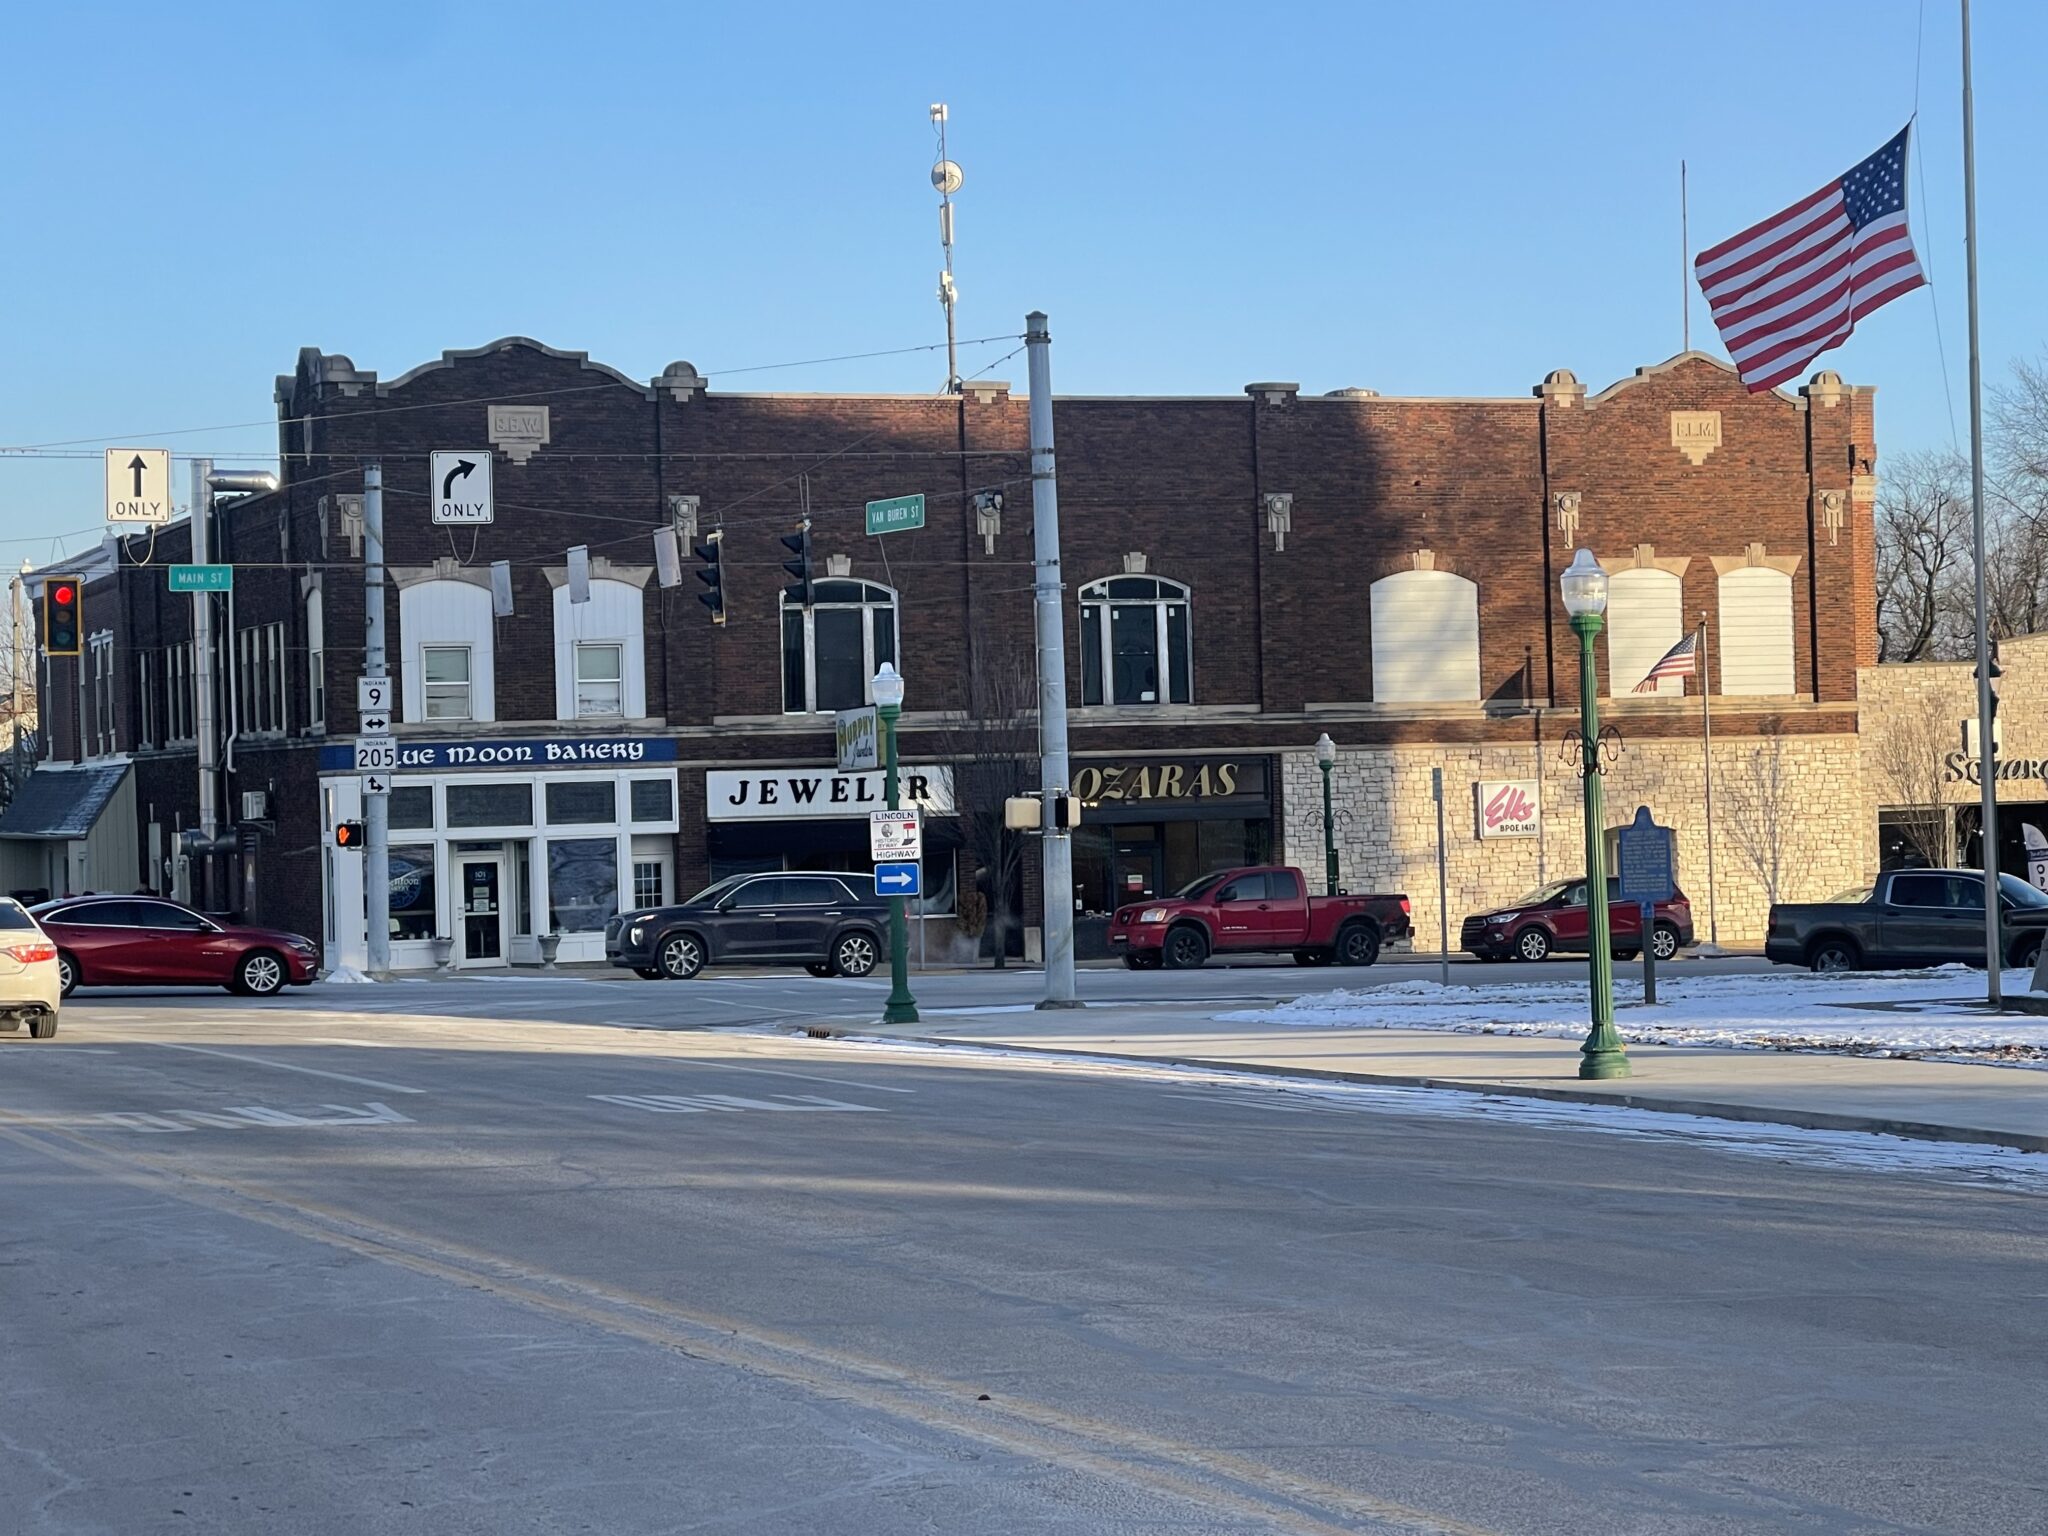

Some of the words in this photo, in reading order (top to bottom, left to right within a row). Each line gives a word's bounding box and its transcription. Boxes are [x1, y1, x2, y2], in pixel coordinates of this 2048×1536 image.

[115, 501, 161, 516] ONLY
[442, 503, 484, 517] ONLY
[872, 511, 884, 524] VAN
[887, 508, 907, 522] BUREN
[911, 505, 919, 518] ST
[178, 572, 204, 584] MAIN
[210, 572, 223, 584] ST
[369, 688, 381, 706] 9
[358, 749, 395, 767] 205
[446, 746, 534, 763] Moon
[545, 741, 644, 761] Bakery
[1071, 763, 1239, 801] OZARAS
[875, 811, 914, 820] LINCOLN
[1485, 785, 1536, 828] Elks
[1500, 824, 1519, 832] BPOE
[1521, 823, 1536, 832] 1417
[876, 850, 916, 859] HIGHWAY
[586, 1094, 890, 1113] ONLY
[92, 1101, 417, 1133] ONLY
